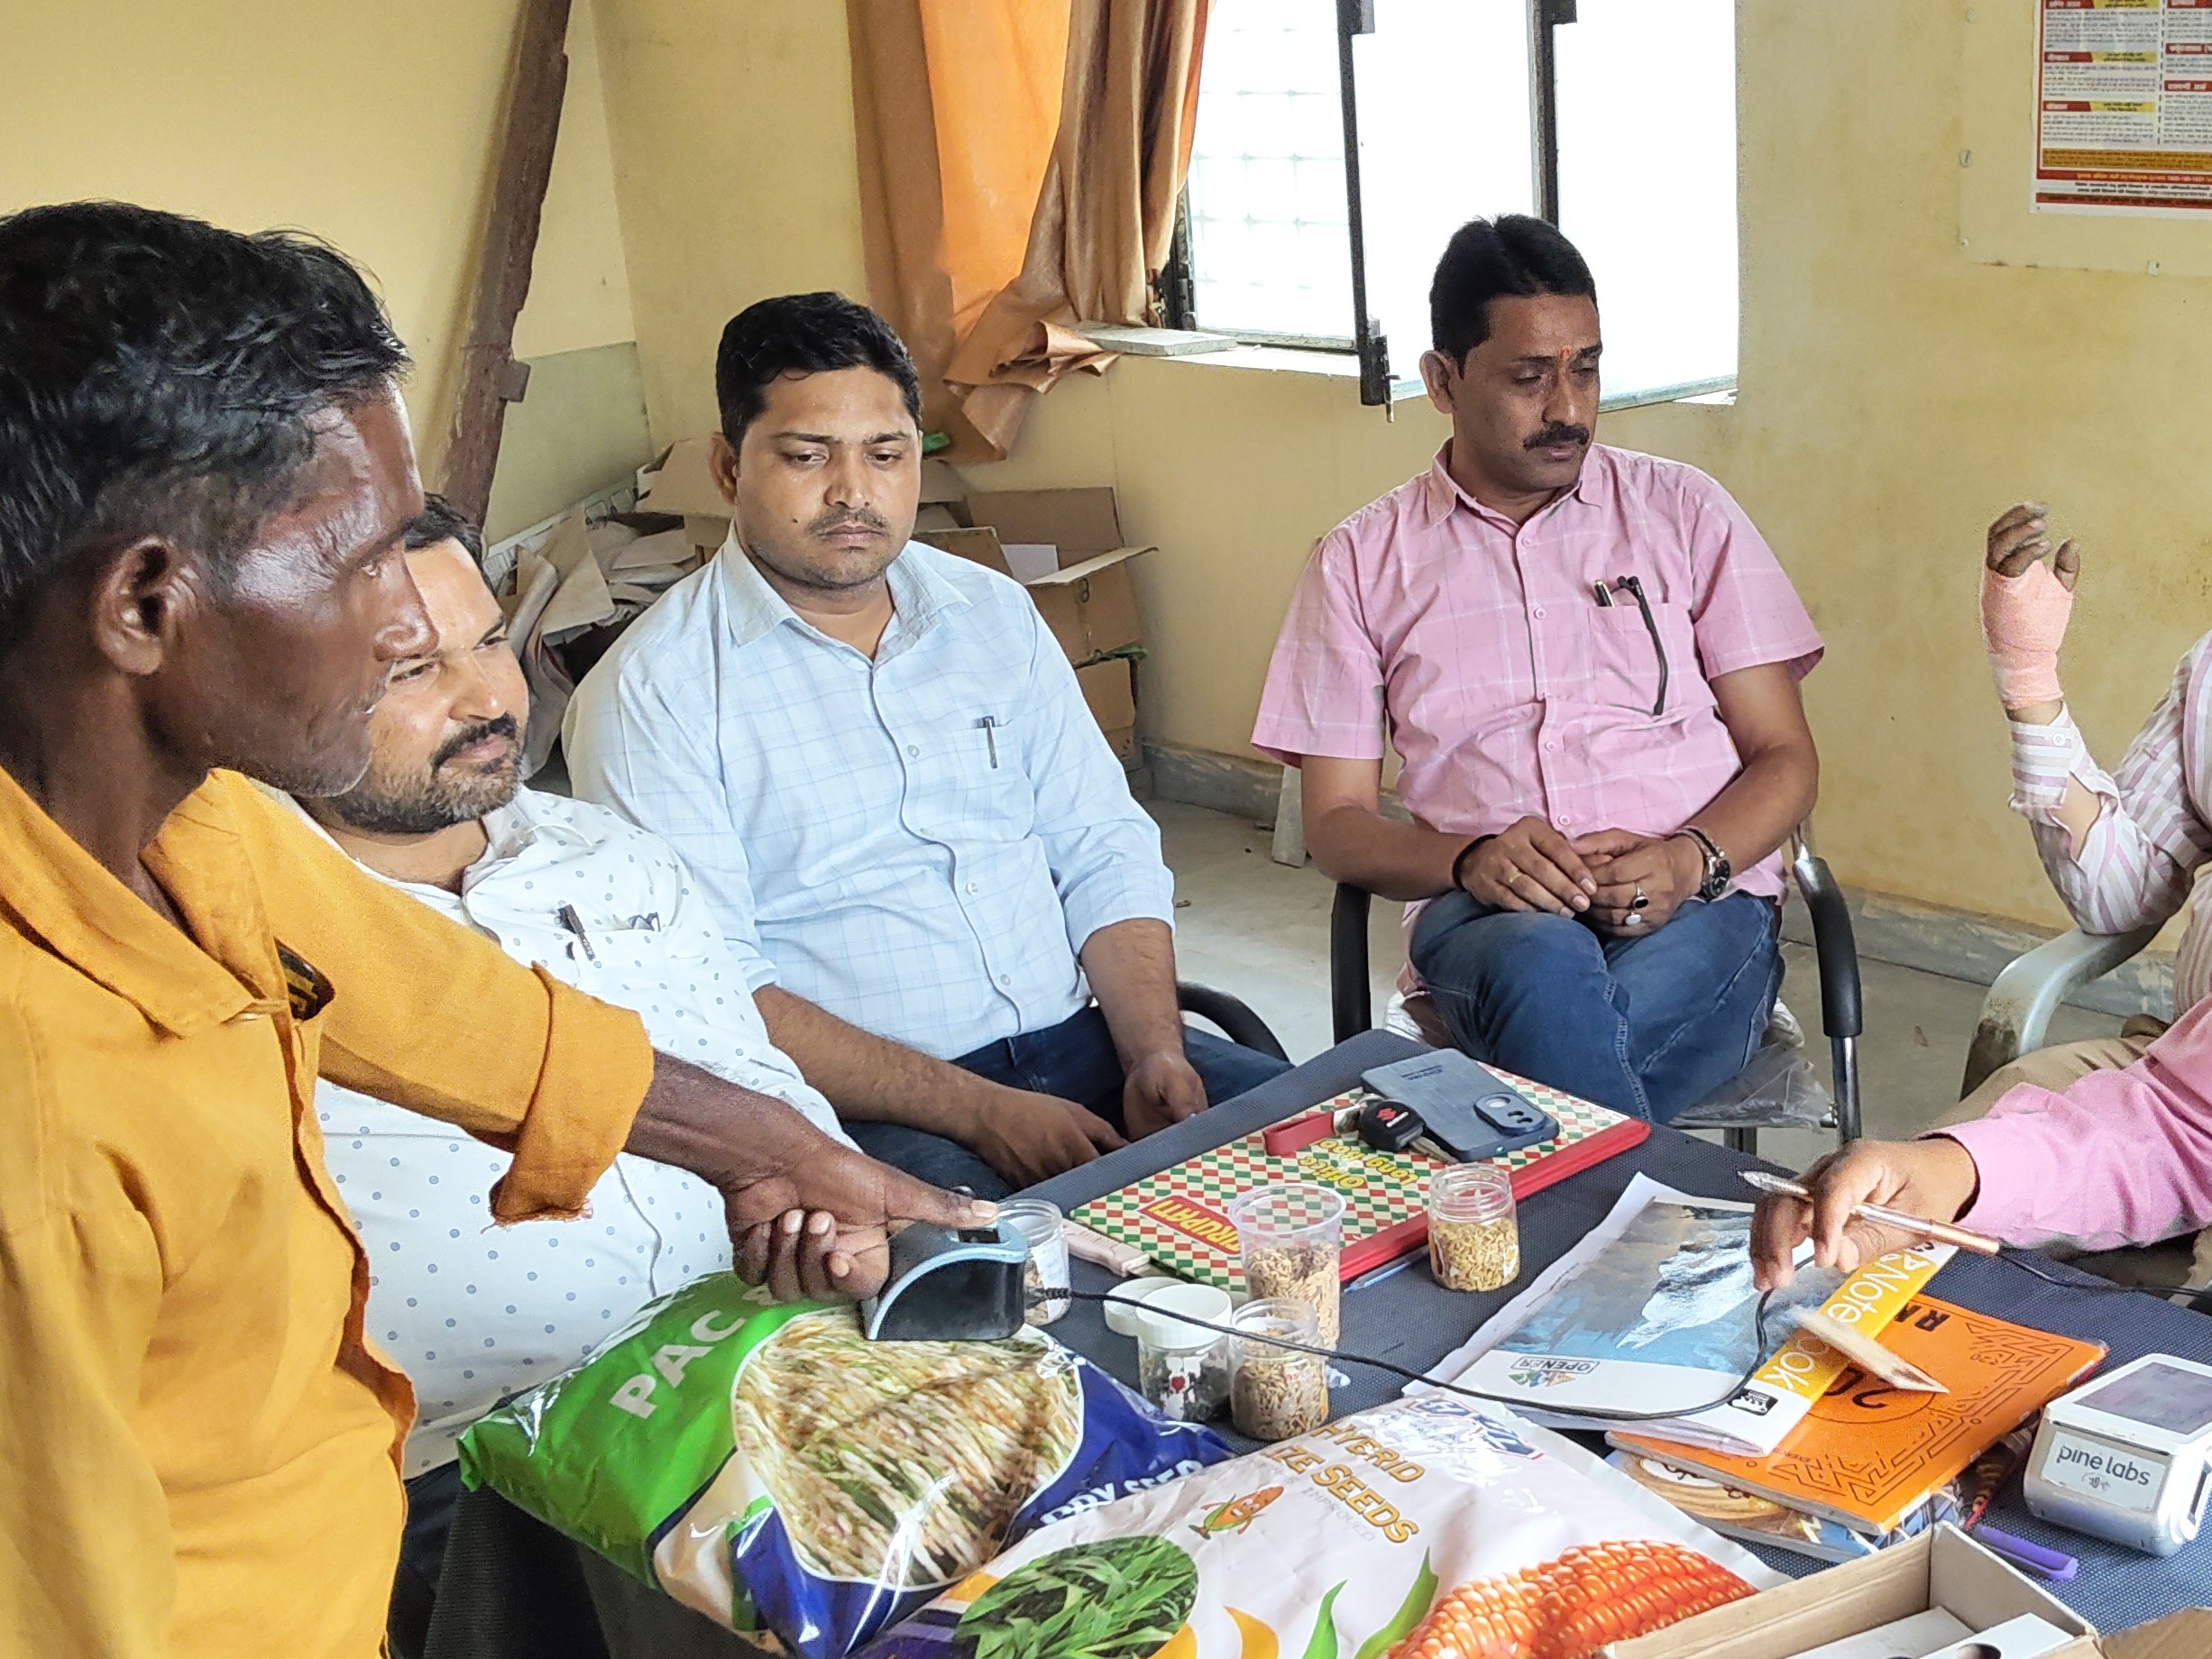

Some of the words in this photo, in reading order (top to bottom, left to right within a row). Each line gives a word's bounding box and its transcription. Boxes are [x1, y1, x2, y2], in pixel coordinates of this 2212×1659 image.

[1365, 1157, 1419, 1186] Long
[1148, 1199, 1241, 1252] TIRUPATI
[609, 1310, 748, 1419] PAC
[1519, 1359, 1592, 1371] OPENER
[2056, 1444, 2103, 1470] pine
[2106, 1456, 2151, 1485] labs
[1311, 1463, 1419, 1544] SEEDS
